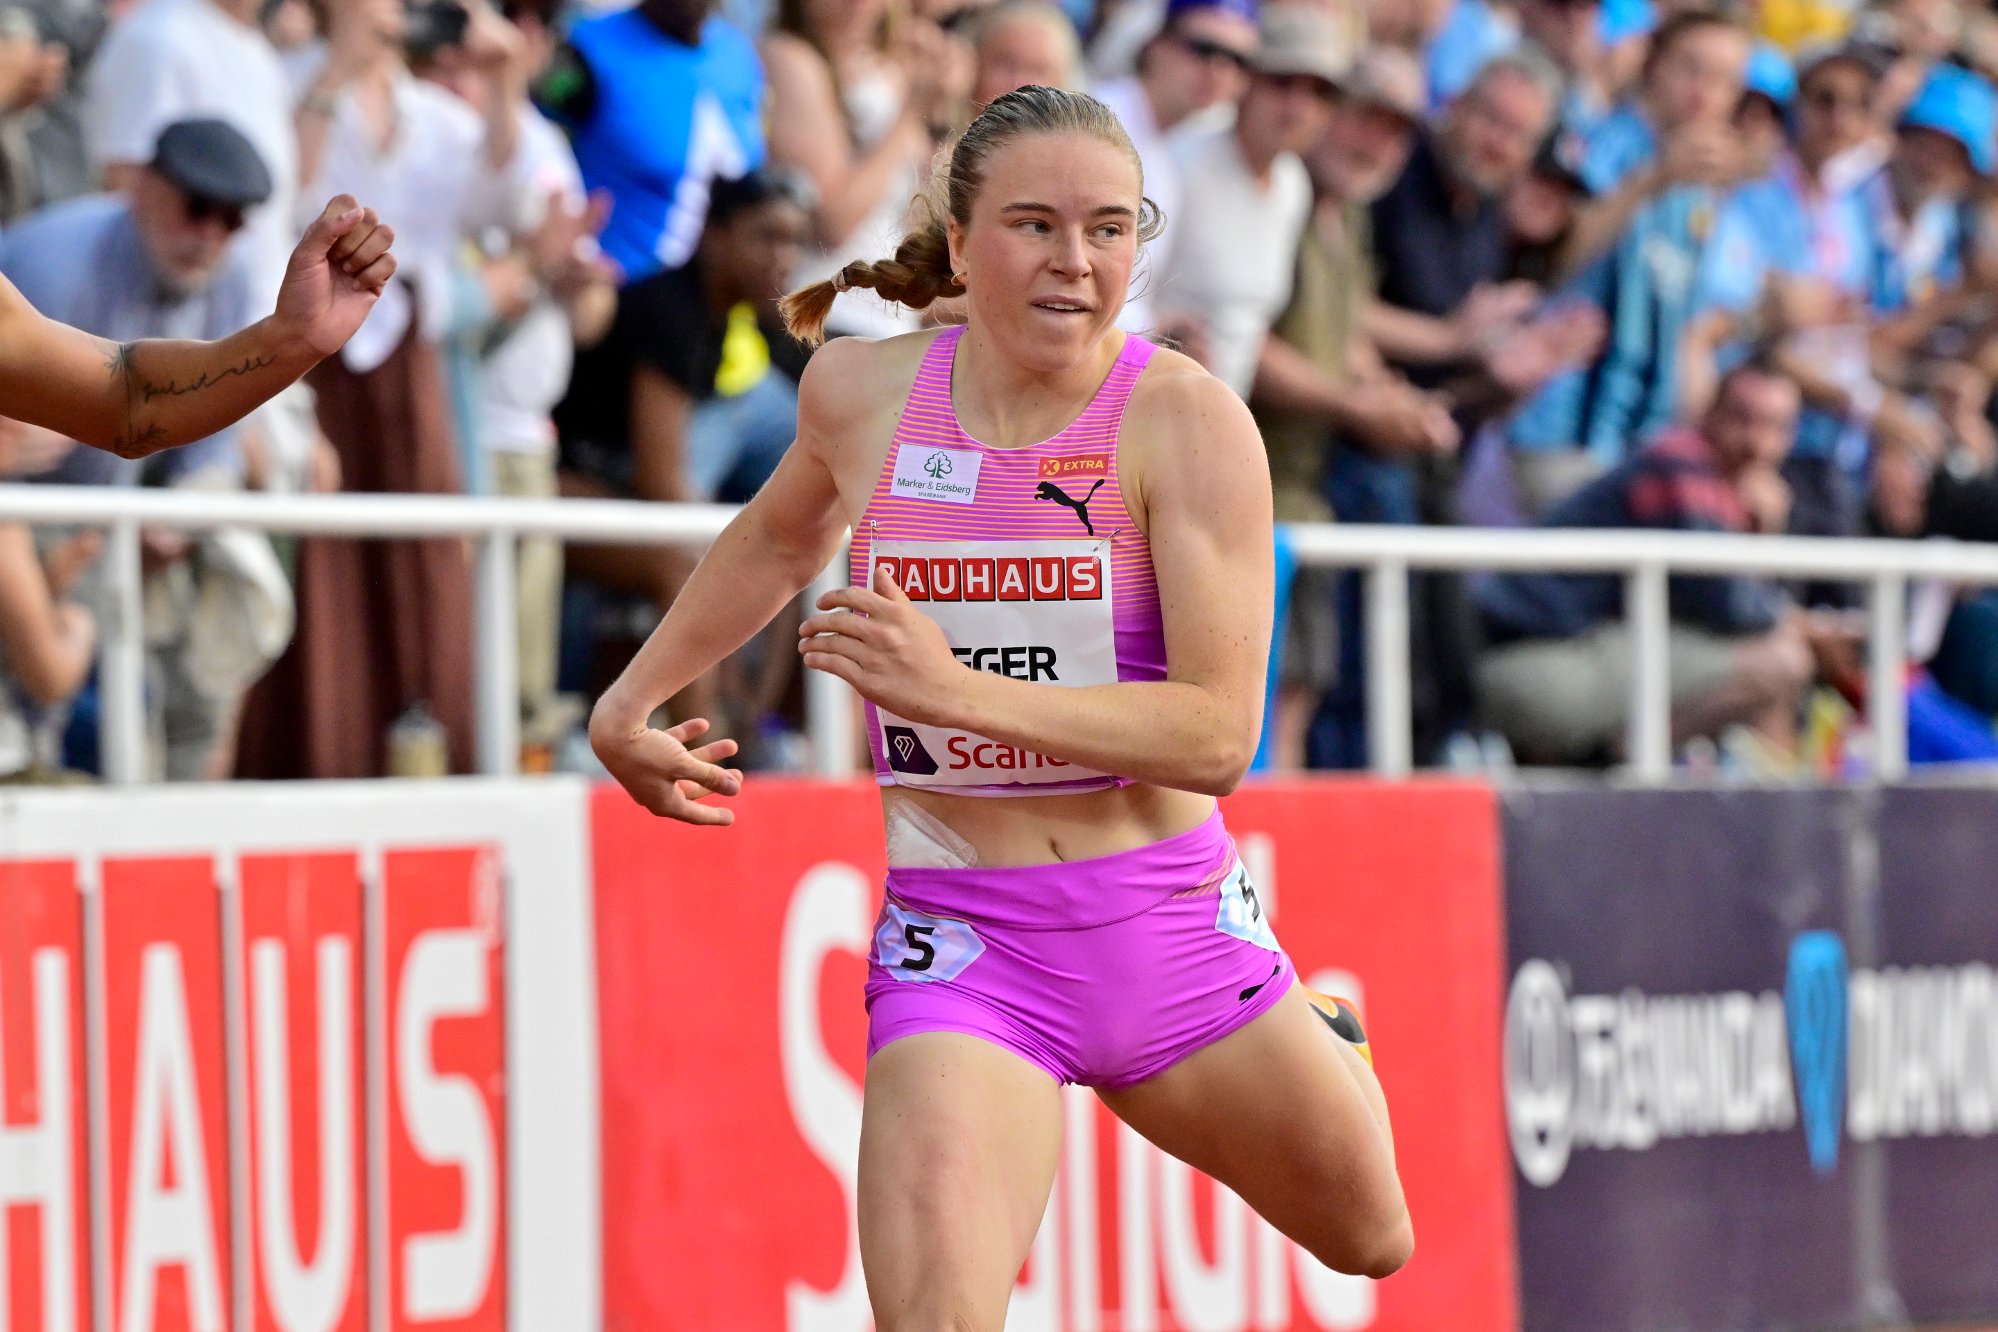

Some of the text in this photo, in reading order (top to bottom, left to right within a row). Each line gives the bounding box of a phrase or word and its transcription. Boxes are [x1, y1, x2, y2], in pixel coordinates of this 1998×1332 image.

[1063, 460, 1104, 471] EXTRA
[897, 478, 971, 495] Marker & Eidsberg
[900, 923, 935, 971] 5
